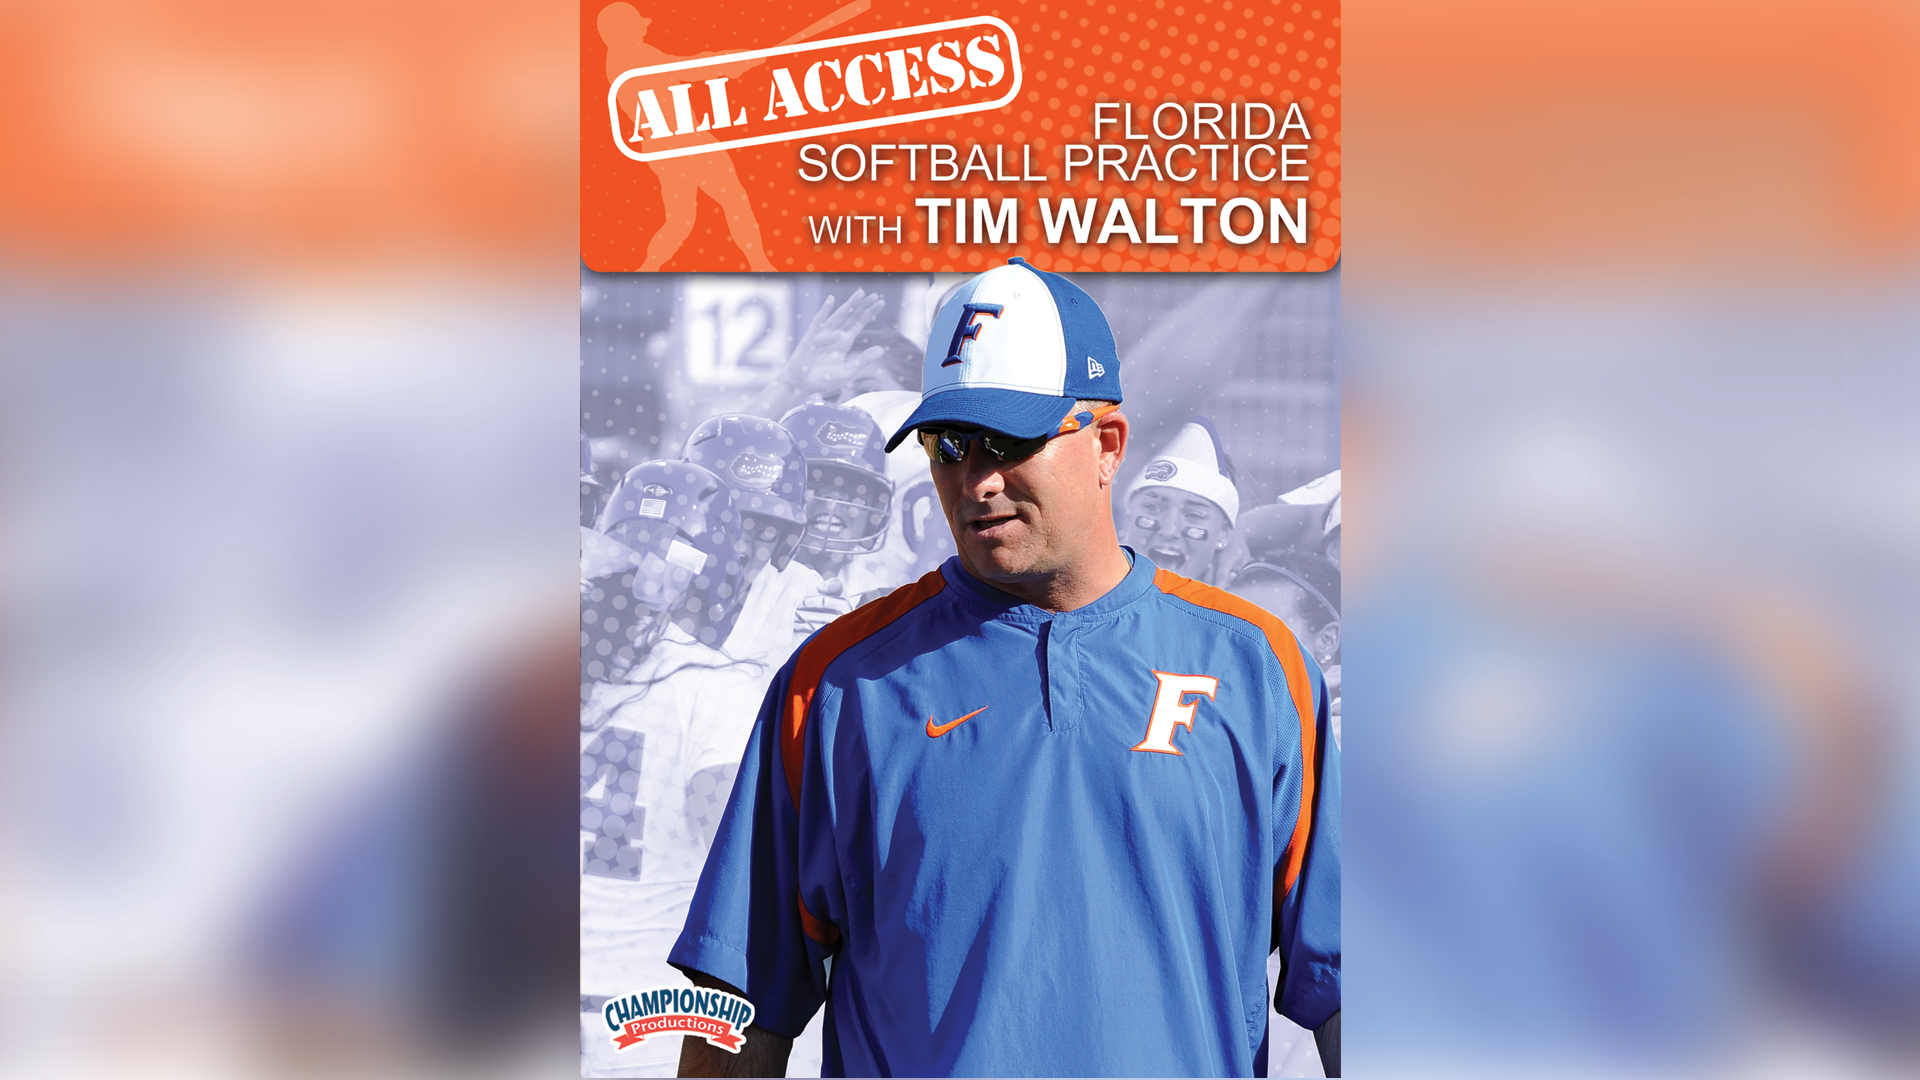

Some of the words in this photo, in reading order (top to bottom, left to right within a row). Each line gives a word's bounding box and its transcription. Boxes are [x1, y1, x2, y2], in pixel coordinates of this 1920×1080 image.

[698, 295, 776, 371] 12
[941, 302, 1004, 368] F
[1129, 669, 1220, 756] F
